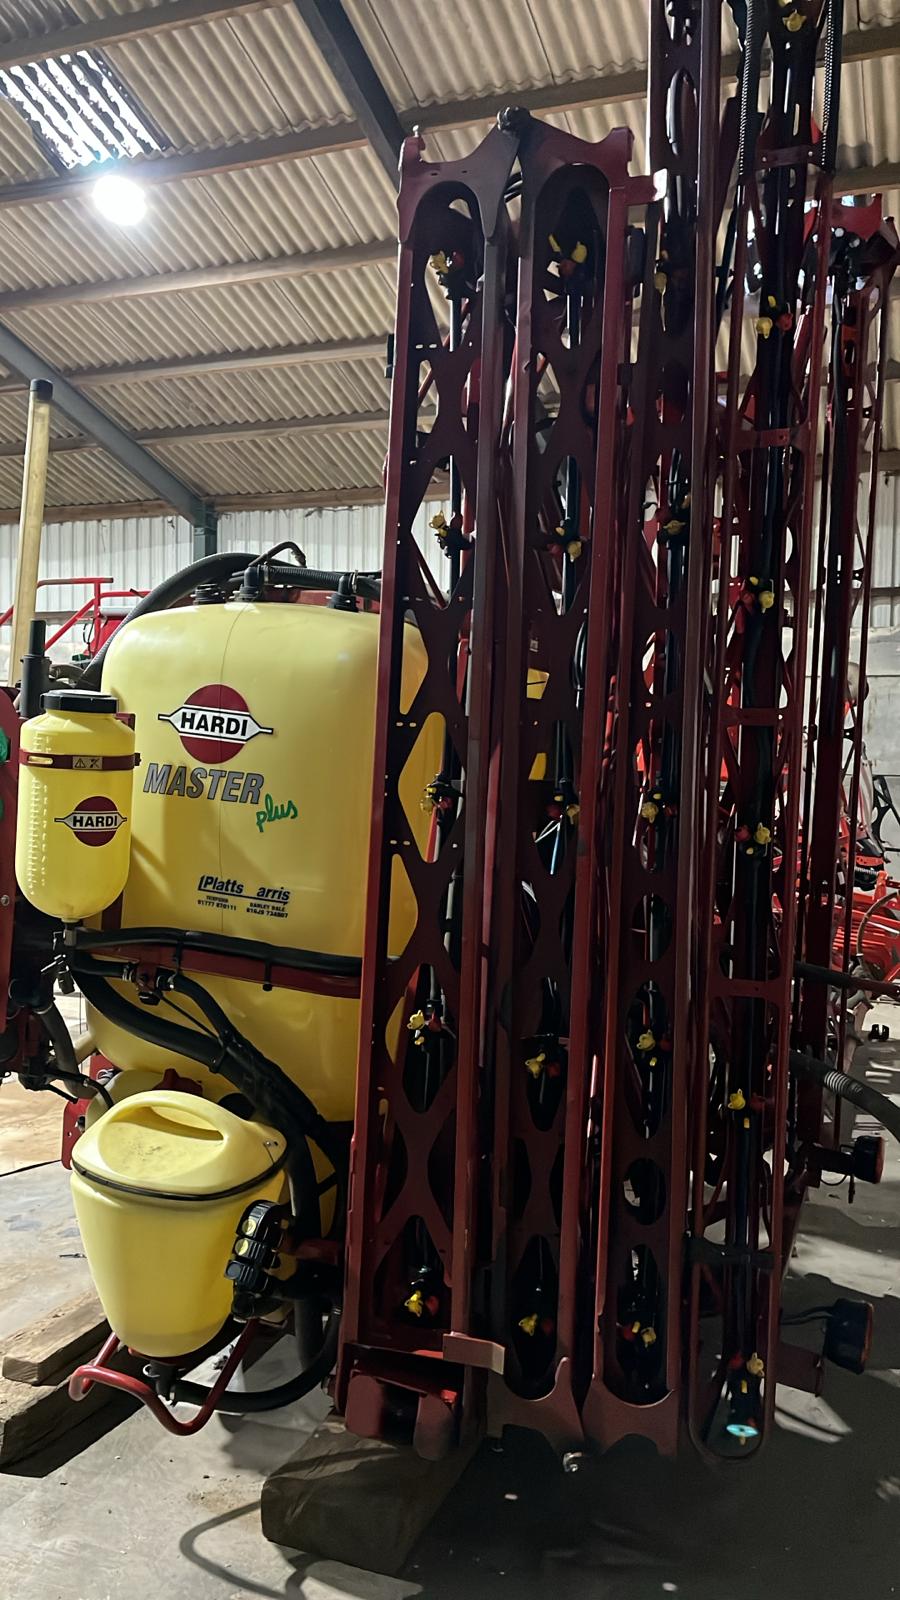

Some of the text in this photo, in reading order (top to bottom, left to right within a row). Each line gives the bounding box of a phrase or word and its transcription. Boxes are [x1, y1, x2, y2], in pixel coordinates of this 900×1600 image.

[180, 712, 248, 737] HARDI
[143, 762, 264, 804] MASTER
[72, 814, 118, 829] HARDI
[256, 793, 298, 833] plus
[203, 876, 244, 894] Platts
